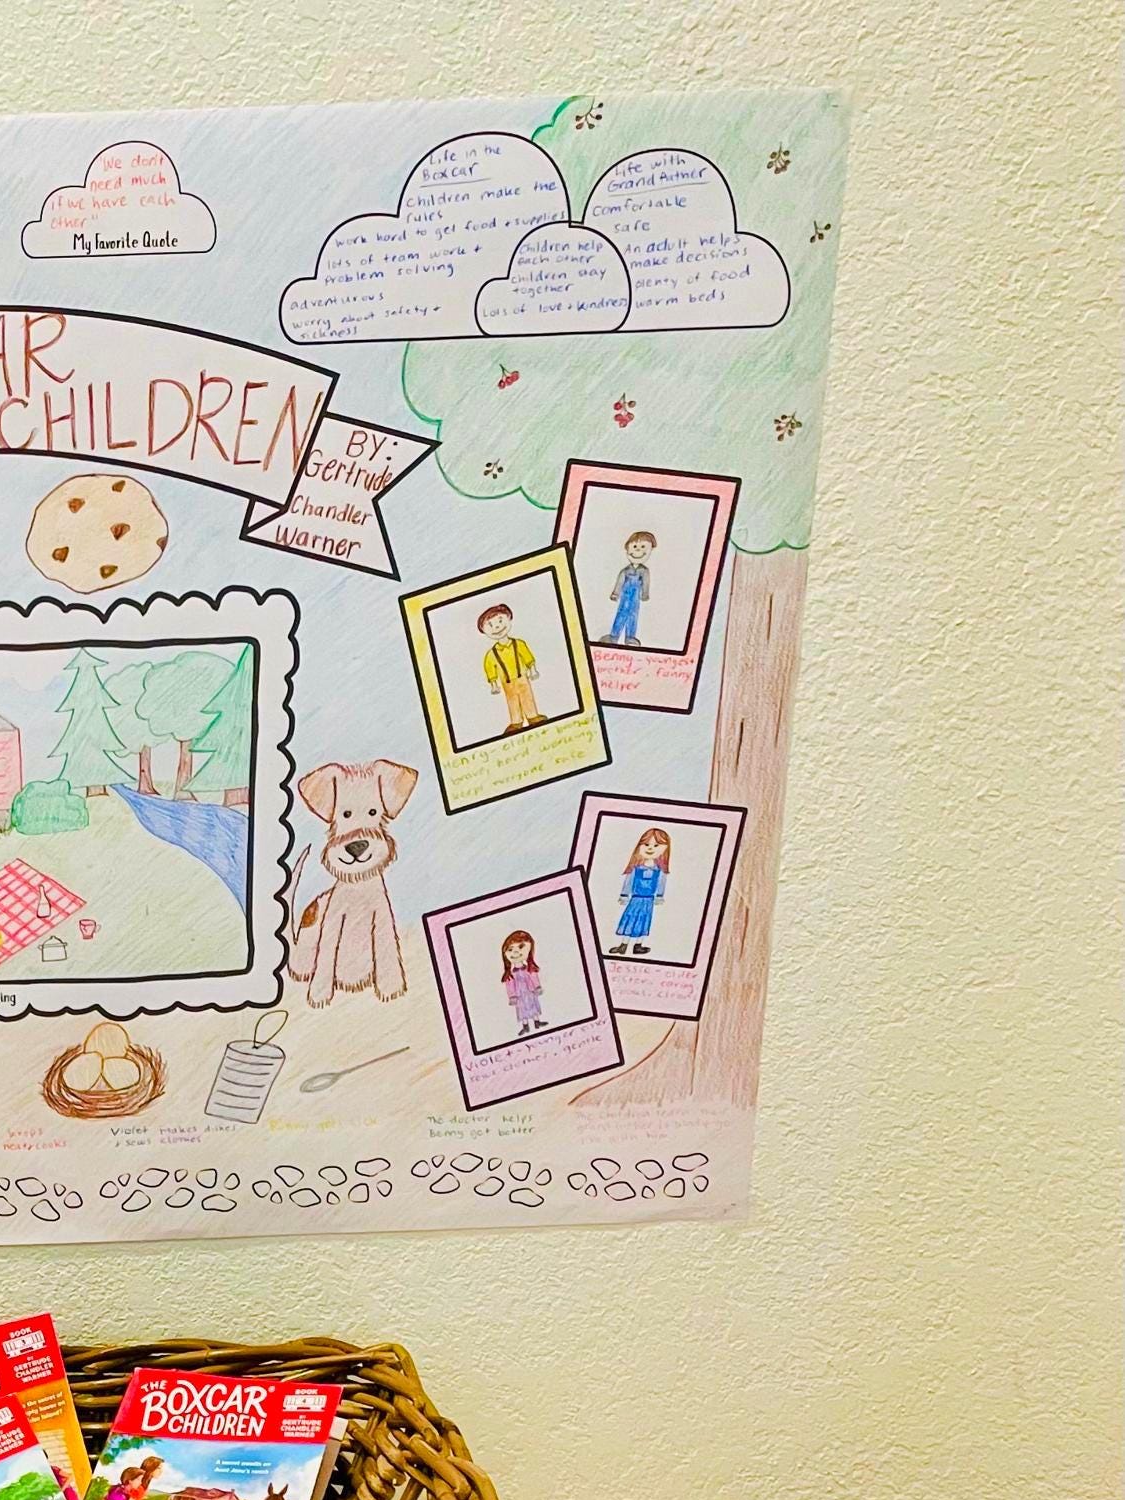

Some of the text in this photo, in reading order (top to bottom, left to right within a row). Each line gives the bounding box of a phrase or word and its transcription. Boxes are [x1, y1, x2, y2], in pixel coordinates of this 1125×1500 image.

[132, 174, 166, 185] much
[92, 194, 127, 208] have
[73, 231, 178, 252] My Favorite Quote
[346, 430, 400, 457] BY:
[304, 448, 392, 492] Gertrude
[290, 497, 374, 526] Chandler
[275, 523, 363, 556] Warner
[10, 1327, 31, 1338] BOOK
[141, 1379, 267, 1432] THE BOXCAR
[168, 1413, 265, 1437] CHILDREN
